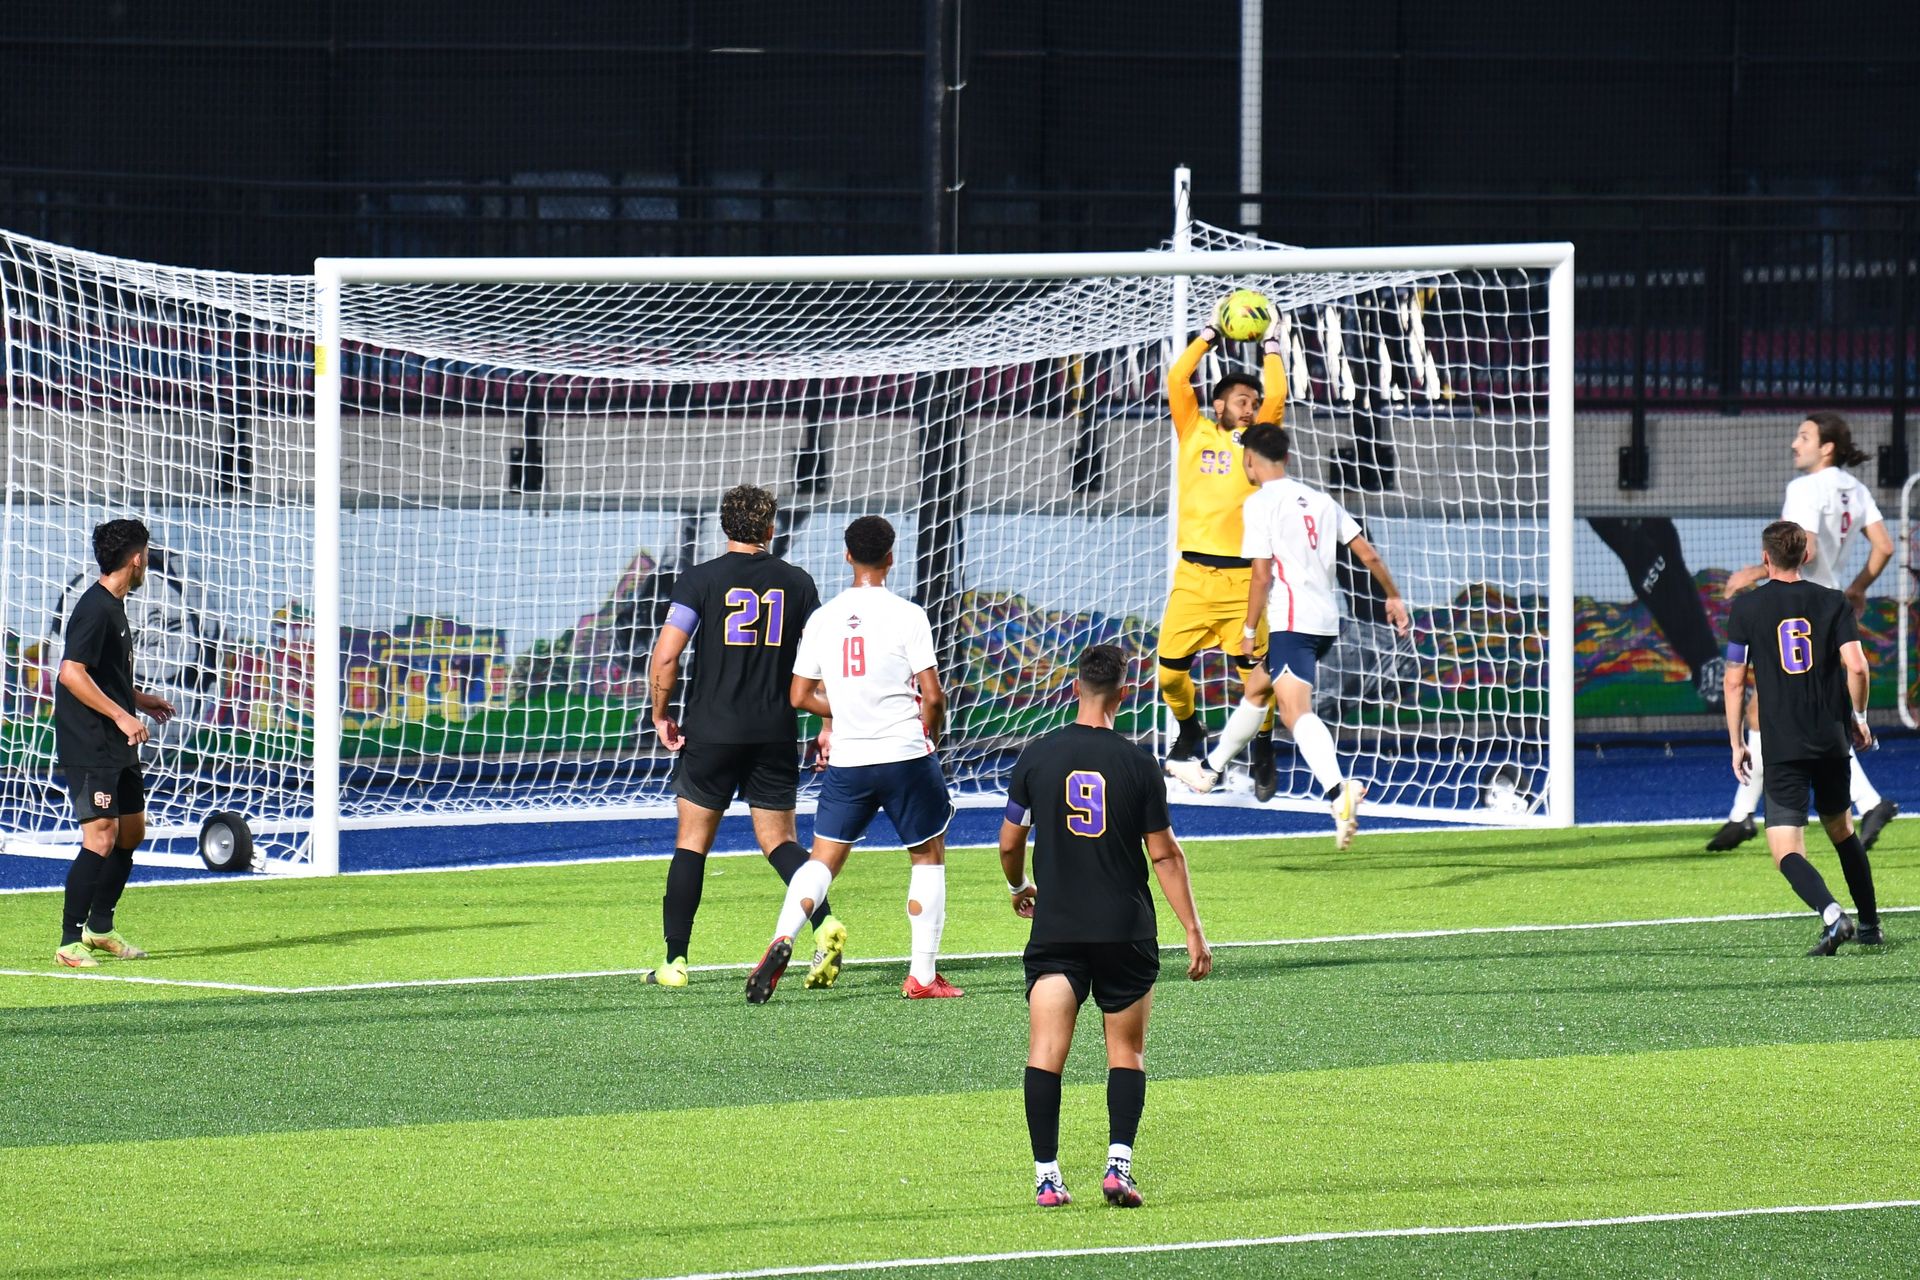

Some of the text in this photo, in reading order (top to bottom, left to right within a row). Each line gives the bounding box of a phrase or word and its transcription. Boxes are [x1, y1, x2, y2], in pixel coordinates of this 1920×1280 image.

[1200, 449, 1232, 474] 99
[1303, 515, 1318, 551] 8
[725, 587, 785, 647] 21
[842, 636, 866, 678] 19
[1777, 617, 1813, 675] 6
[94, 791, 112, 809] SF
[1065, 769, 1107, 838] 9
